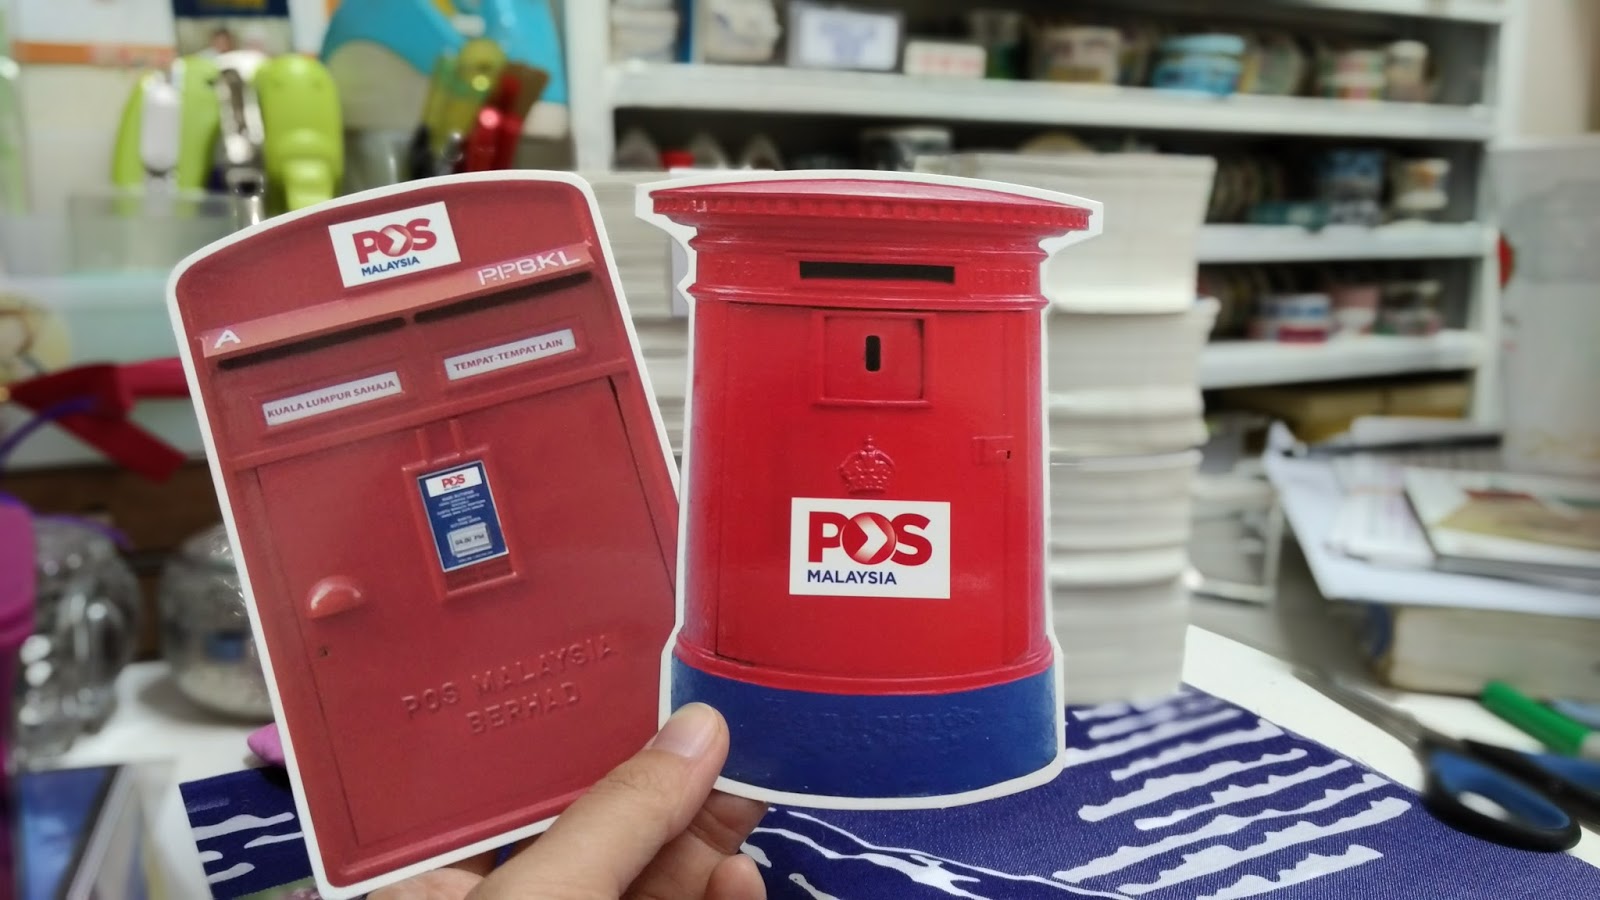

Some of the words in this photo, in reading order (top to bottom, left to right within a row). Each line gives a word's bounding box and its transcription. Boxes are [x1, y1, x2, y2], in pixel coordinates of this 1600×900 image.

[352, 218, 437, 264] POS
[361, 256, 421, 277] MALAYSIA
[214, 329, 241, 349] A
[454, 344, 538, 372] TEMPAT-TEMPAT
[539, 338, 564, 352] LAIN
[267, 400, 304, 419] KUALA
[305, 389, 352, 409] LUMPUR
[353, 379, 396, 398] SAHAJA
[441, 474, 465, 488] POS
[808, 511, 933, 566] POS
[807, 569, 897, 585] MALAYSIA
[401, 682, 460, 719] POS
[472, 634, 612, 697] MALAYSIA
[466, 682, 580, 734] BERHAD
